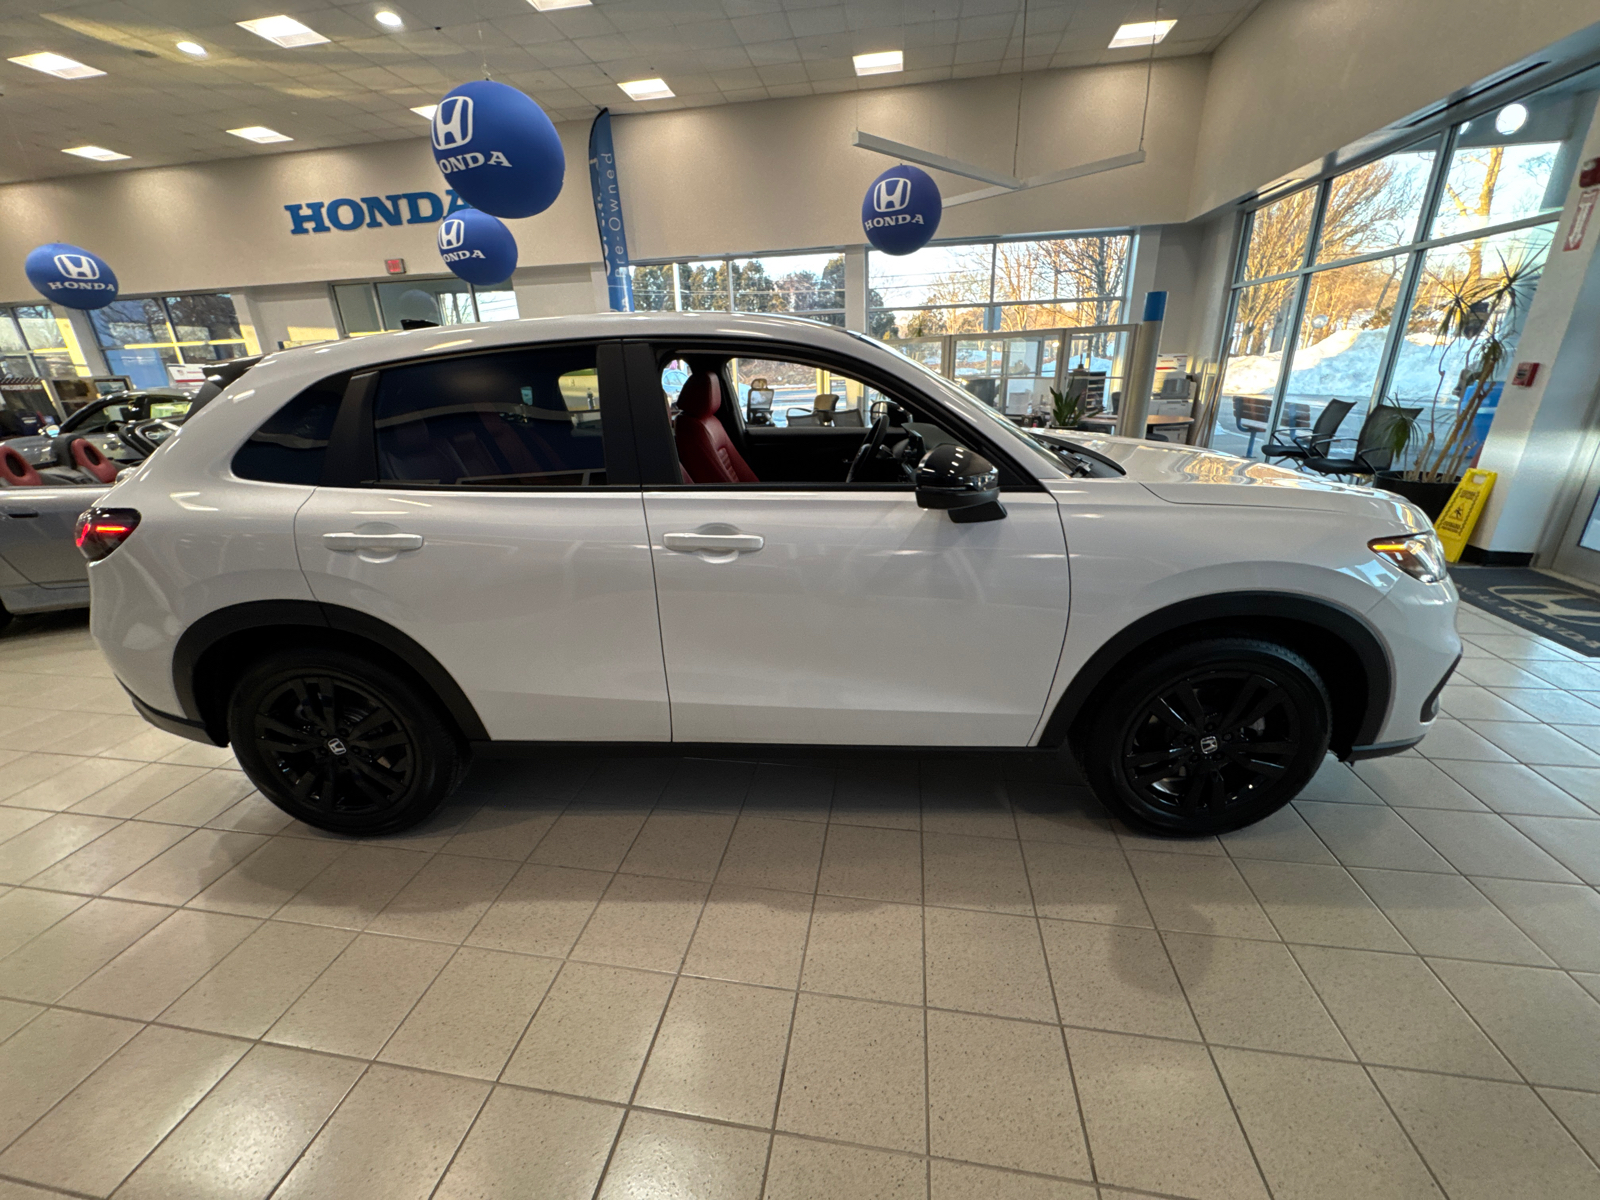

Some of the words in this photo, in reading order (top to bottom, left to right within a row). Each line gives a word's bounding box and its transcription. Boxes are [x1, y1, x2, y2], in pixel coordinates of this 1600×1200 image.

[439, 150, 513, 174] ONDA
[864, 213, 925, 232] HONDA
[442, 249, 487, 263] ONDA
[47, 281, 116, 292] HONDA
